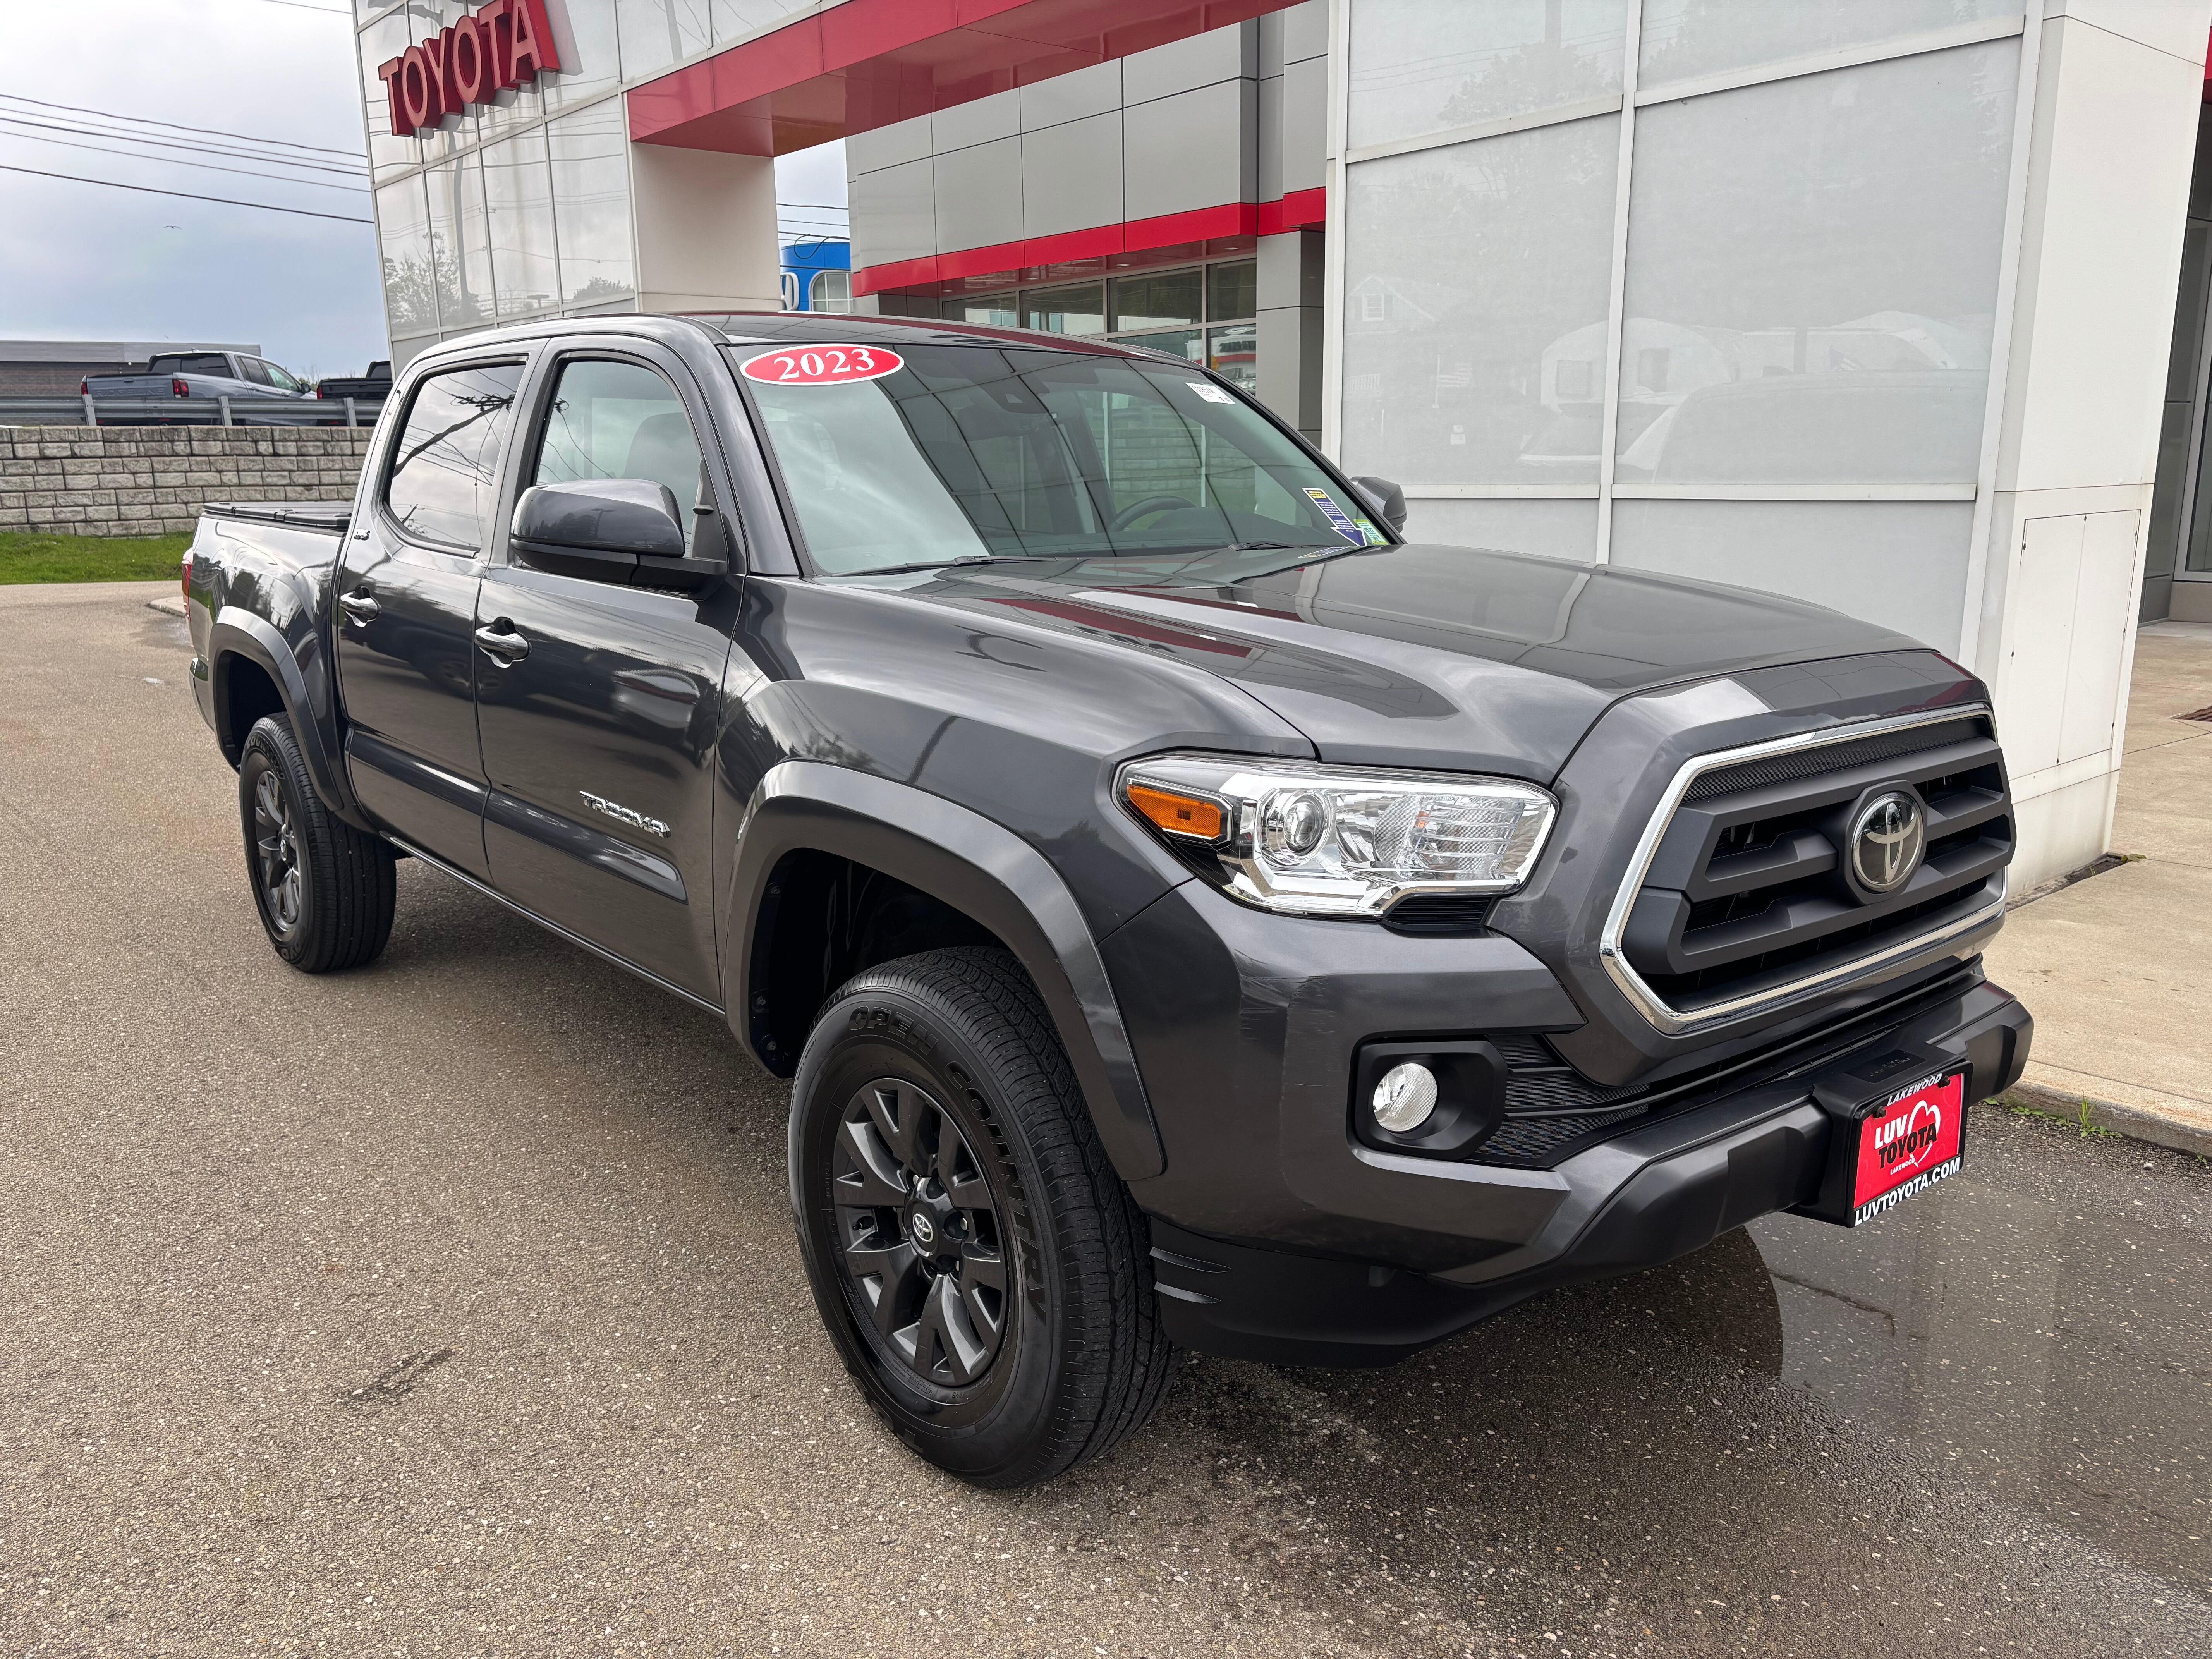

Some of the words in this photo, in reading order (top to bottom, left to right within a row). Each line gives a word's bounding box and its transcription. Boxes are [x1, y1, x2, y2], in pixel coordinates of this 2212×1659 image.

[378, 0, 560, 137] TOYOTA
[773, 348, 875, 380] 2023
[579, 790, 671, 838] TACOMA
[1887, 1073, 1942, 1107] LAKEWOOD
[1875, 1113, 1908, 1150] LUV
[1878, 1122, 1937, 1169] TOYOTA
[848, 1005, 939, 1056] OPEN
[944, 1060, 1047, 1326] COUNTRY
[1889, 1157, 1916, 1175] LAKEWOOD
[1855, 1156, 1960, 1226] LUVTOYOTA.COM
